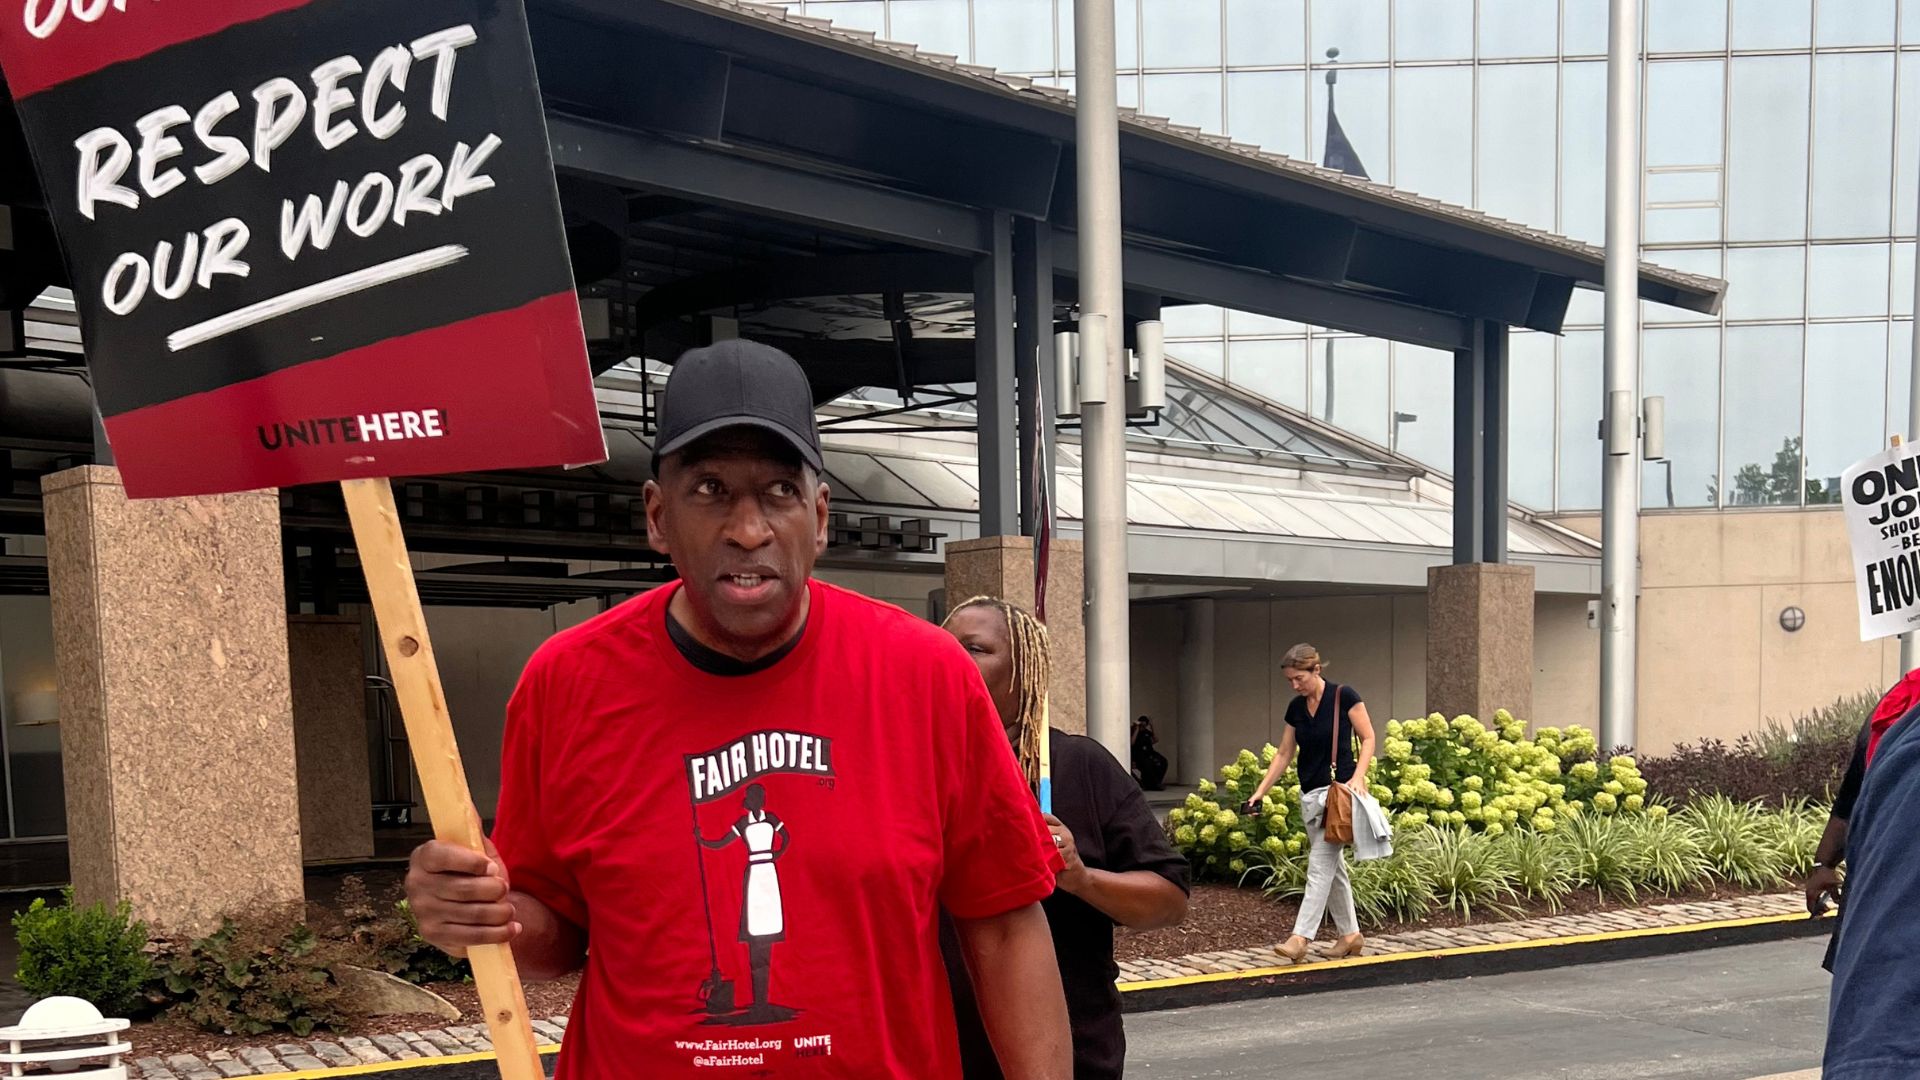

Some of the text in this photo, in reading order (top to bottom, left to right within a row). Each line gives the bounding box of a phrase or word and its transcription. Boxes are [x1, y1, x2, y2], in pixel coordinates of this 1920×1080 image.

[75, 24, 478, 220] RESPECT
[103, 132, 502, 316] OUR WORK
[1852, 455, 1920, 505] ON
[1868, 491, 1920, 526] JO
[691, 732, 828, 800] FAIR HOTEL
[675, 1038, 782, 1050] www.FairHotel.org
[693, 1053, 764, 1067] @aFairHotel
[794, 1034, 831, 1048] UNITE
